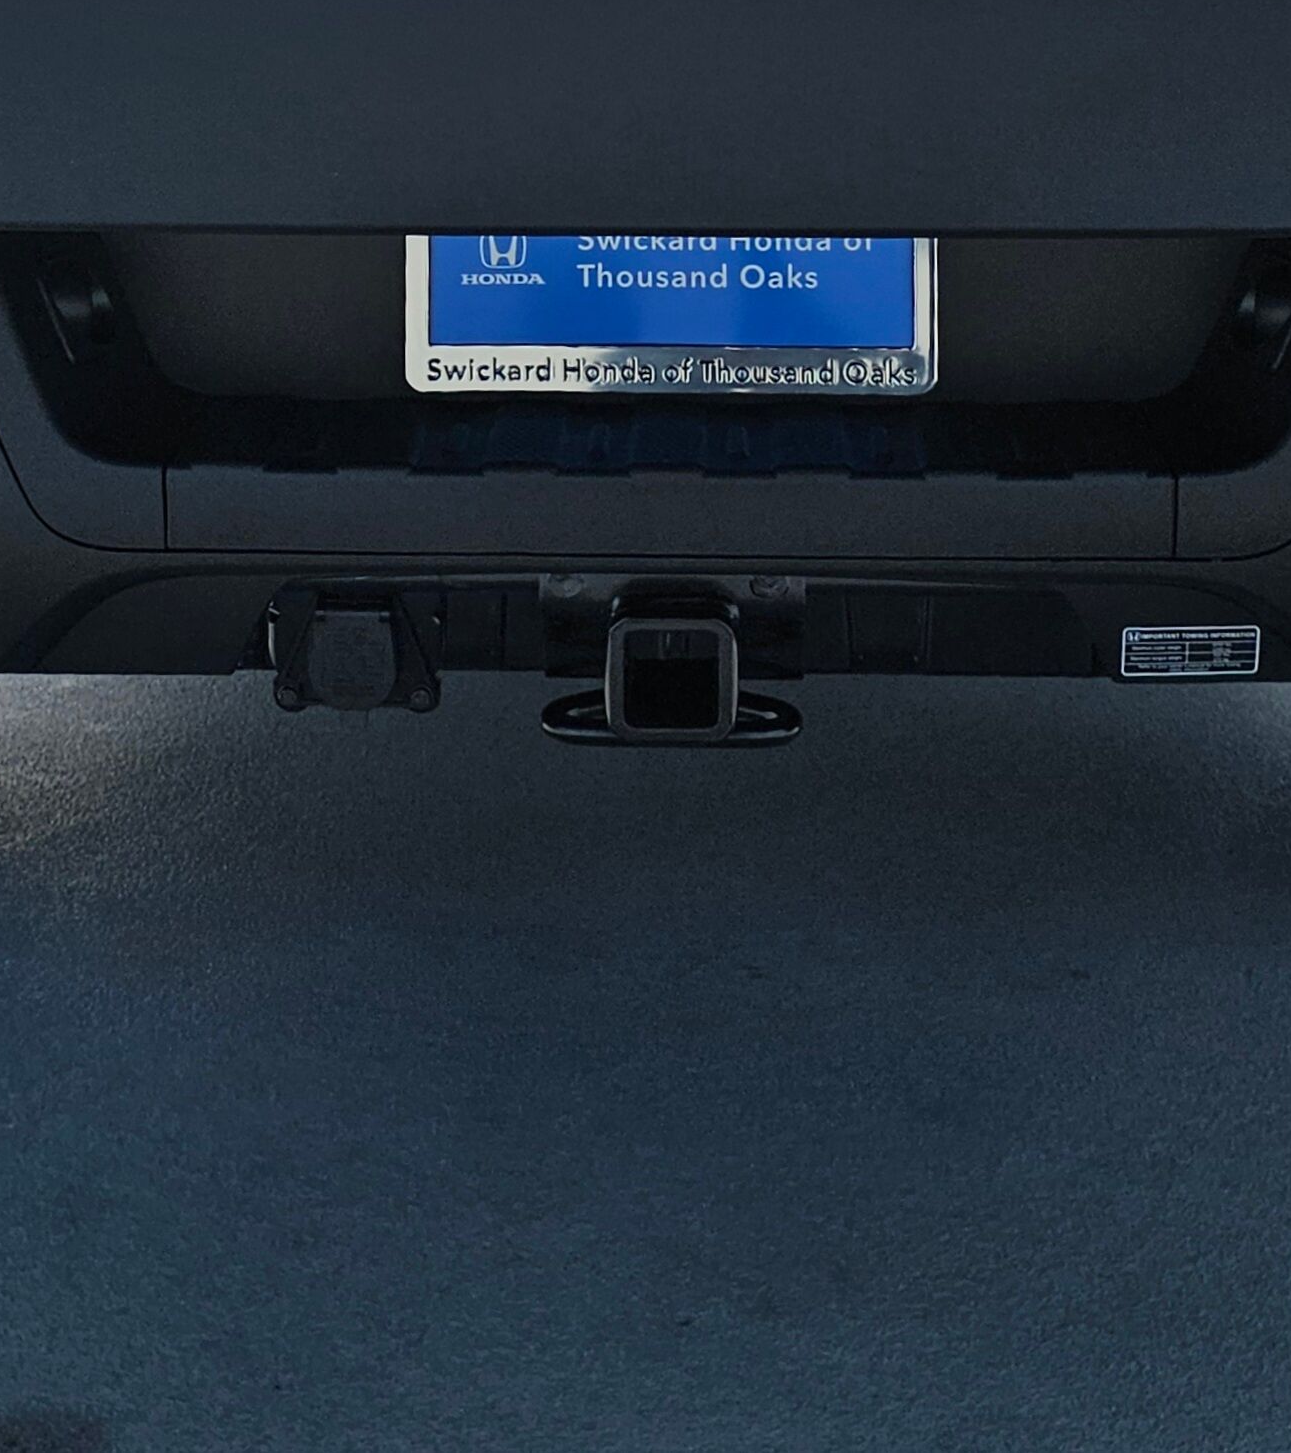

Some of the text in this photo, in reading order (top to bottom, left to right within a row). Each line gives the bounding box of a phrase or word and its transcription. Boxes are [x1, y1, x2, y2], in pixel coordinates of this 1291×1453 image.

[577, 235, 717, 252] Swickard
[730, 236, 831, 252] Honda
[460, 273, 546, 285] HONDA
[576, 262, 818, 289] Thousand Oaks
[427, 356, 918, 386] Swickard Honda of Thousand Oaks
